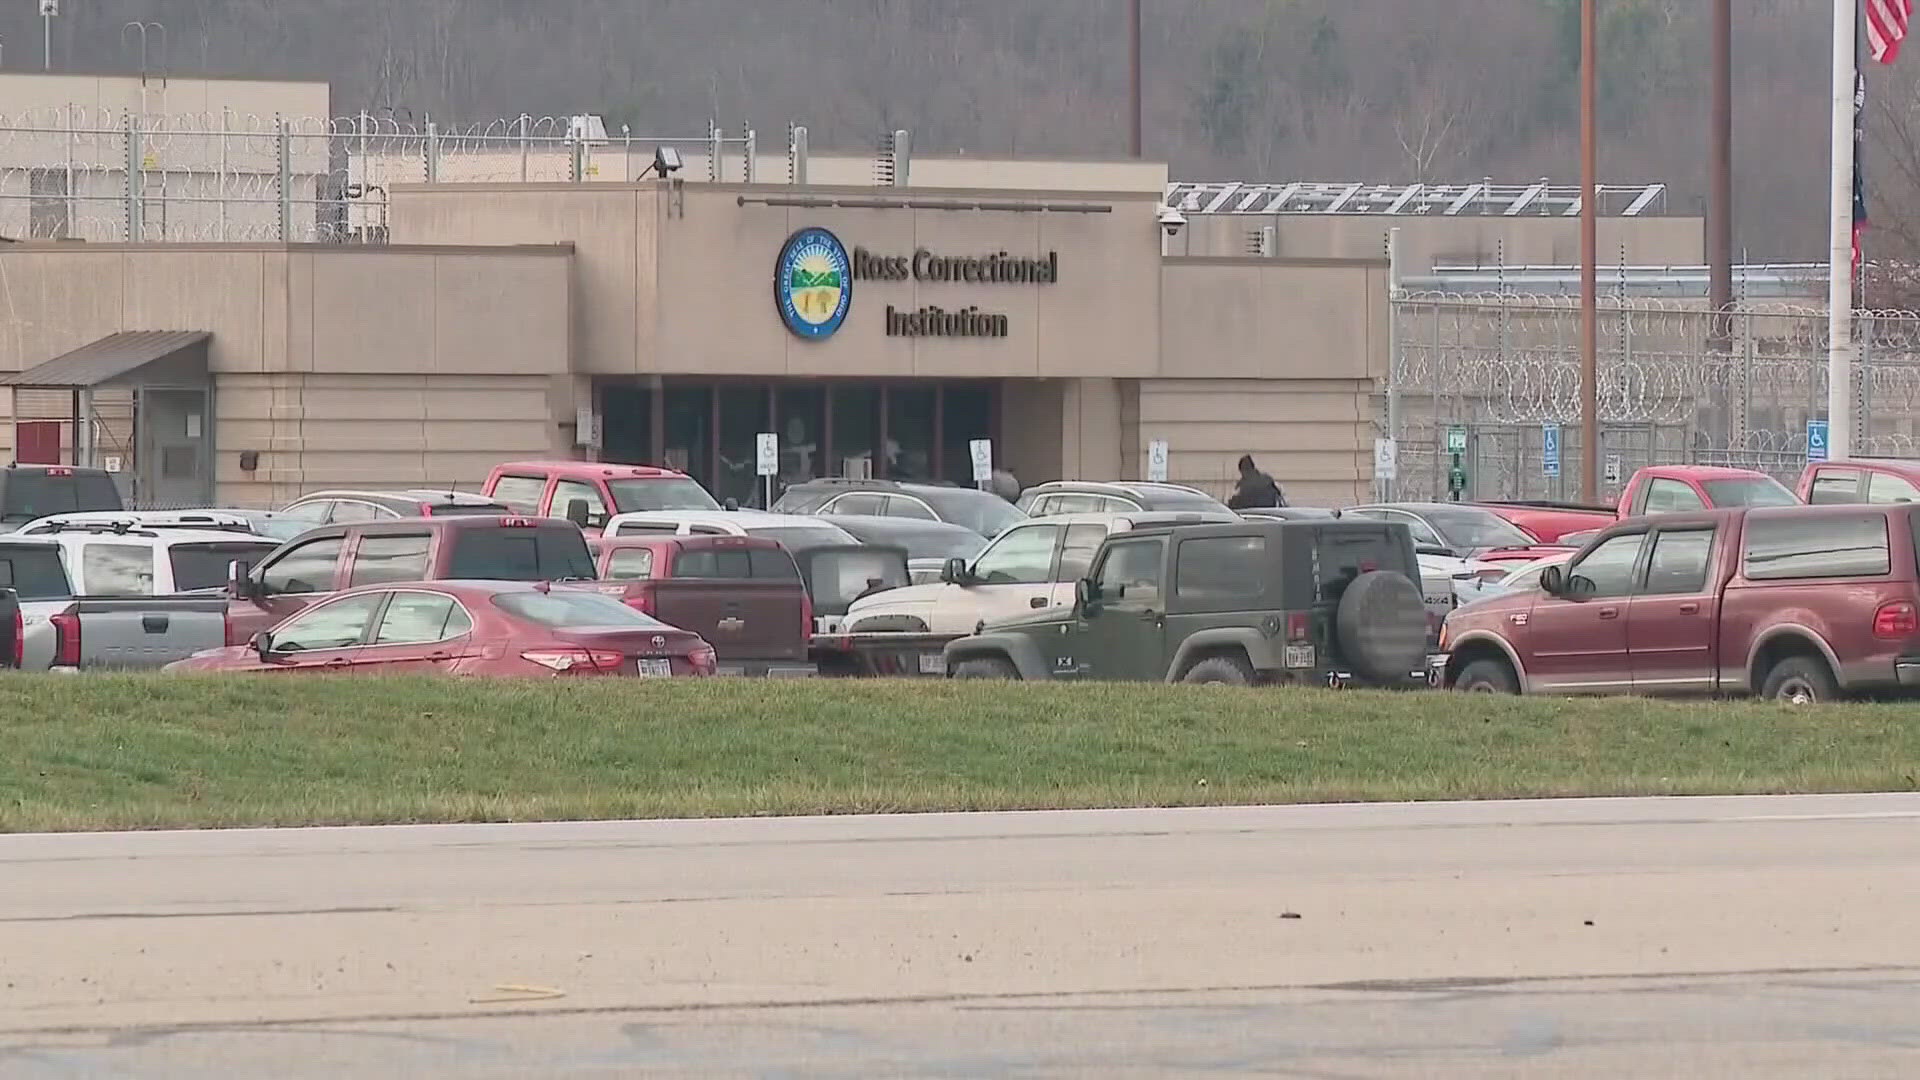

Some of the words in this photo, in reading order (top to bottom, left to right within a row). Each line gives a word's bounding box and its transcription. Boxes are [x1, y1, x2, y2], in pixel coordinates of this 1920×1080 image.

[854, 247, 908, 281] Ross
[912, 248, 1058, 283] Correctional
[886, 304, 1008, 337] Institution
